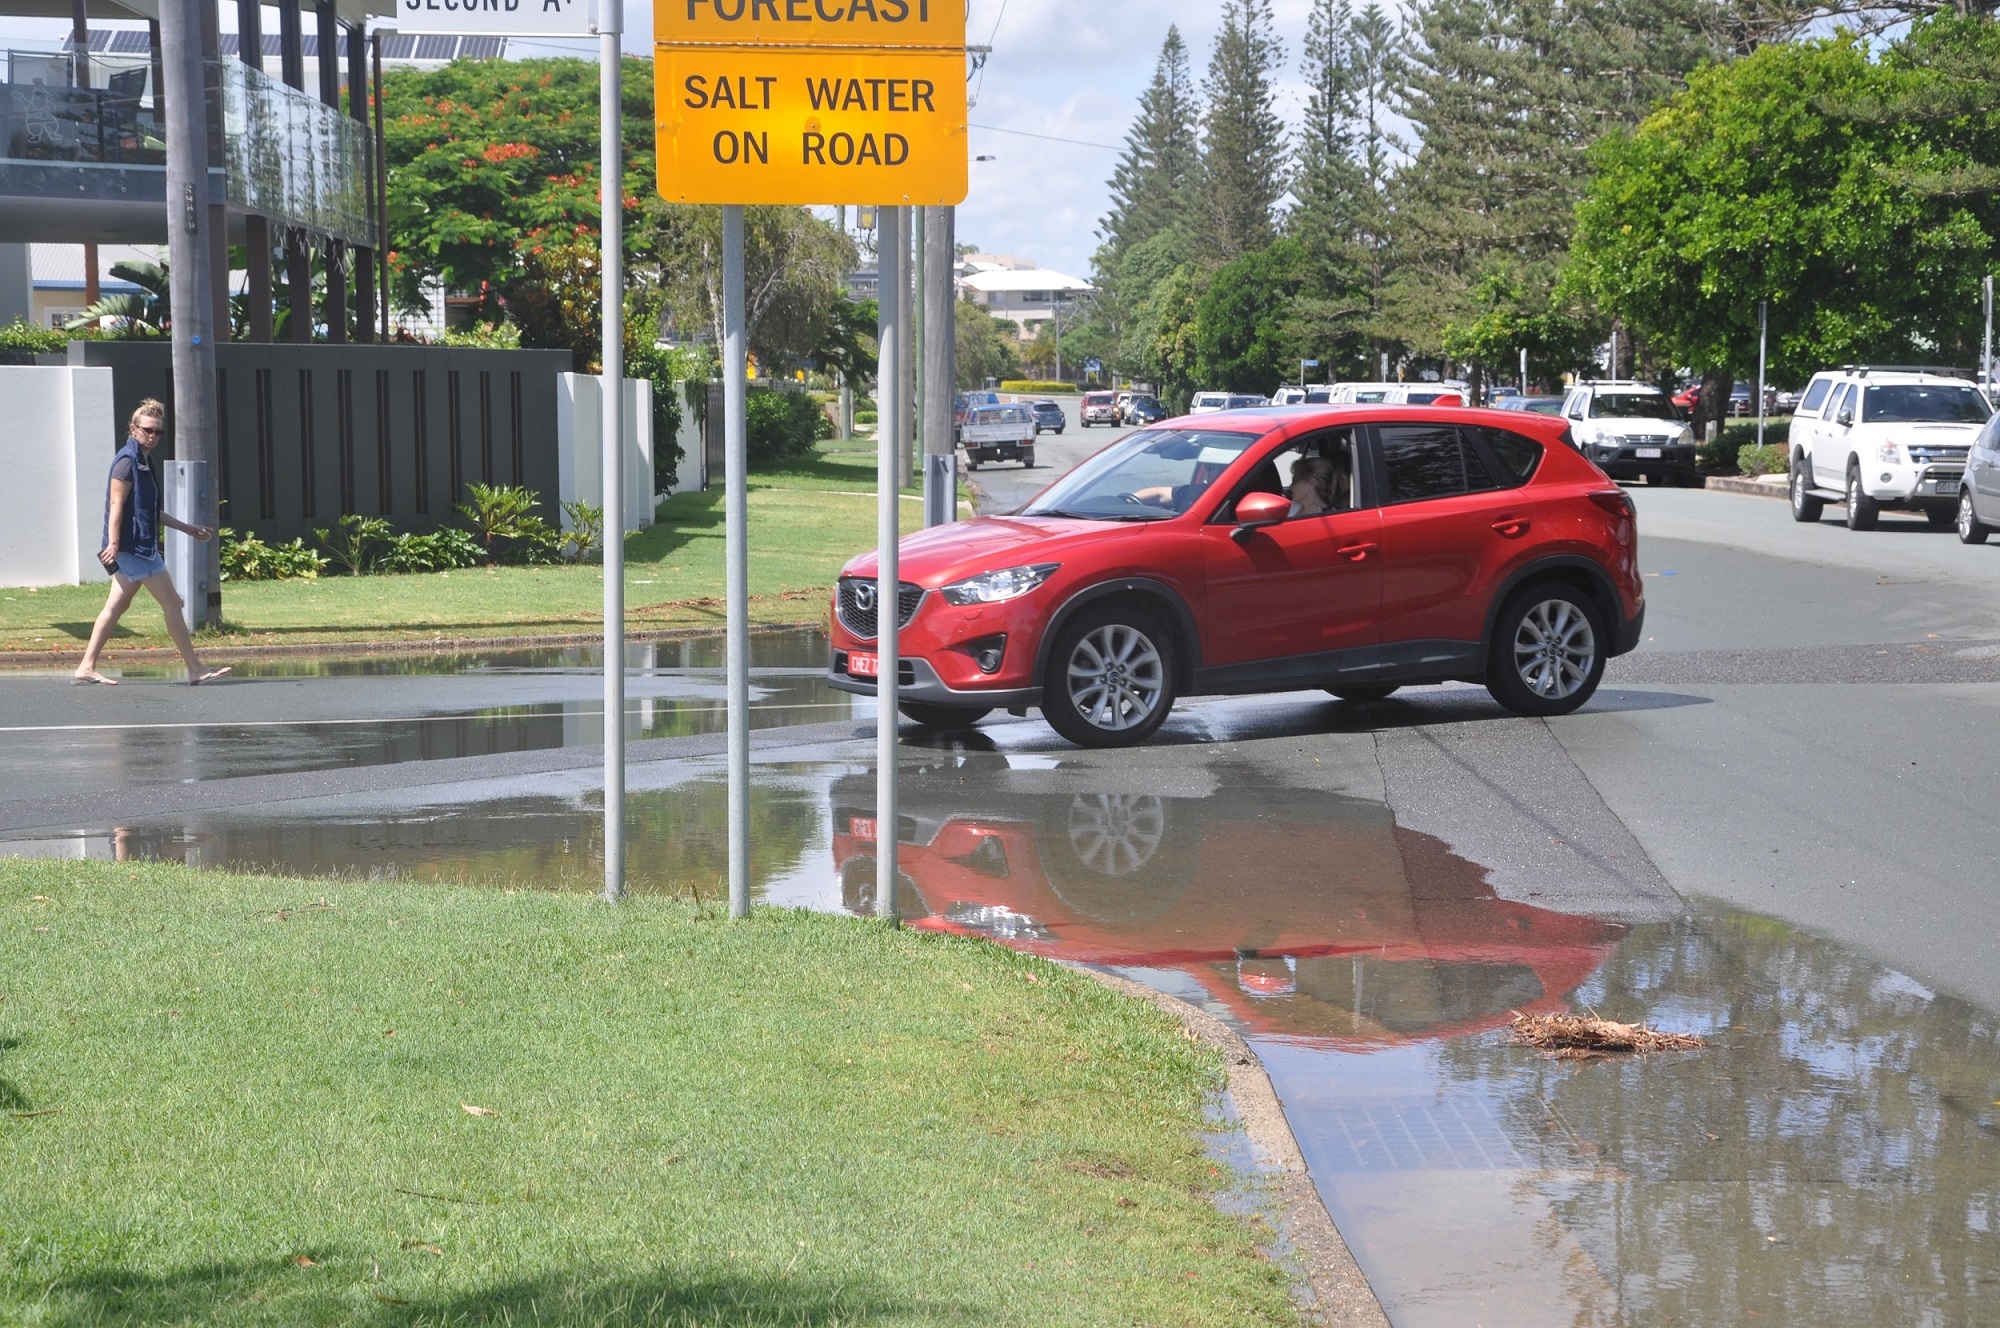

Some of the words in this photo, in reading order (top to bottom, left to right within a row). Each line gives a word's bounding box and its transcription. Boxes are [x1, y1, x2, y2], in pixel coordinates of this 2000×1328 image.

[686, 0, 929, 22] FORECAST
[684, 75, 777, 110] SALT
[805, 77, 936, 112] WATER
[713, 130, 768, 165] ON
[802, 132, 909, 166] ROAD
